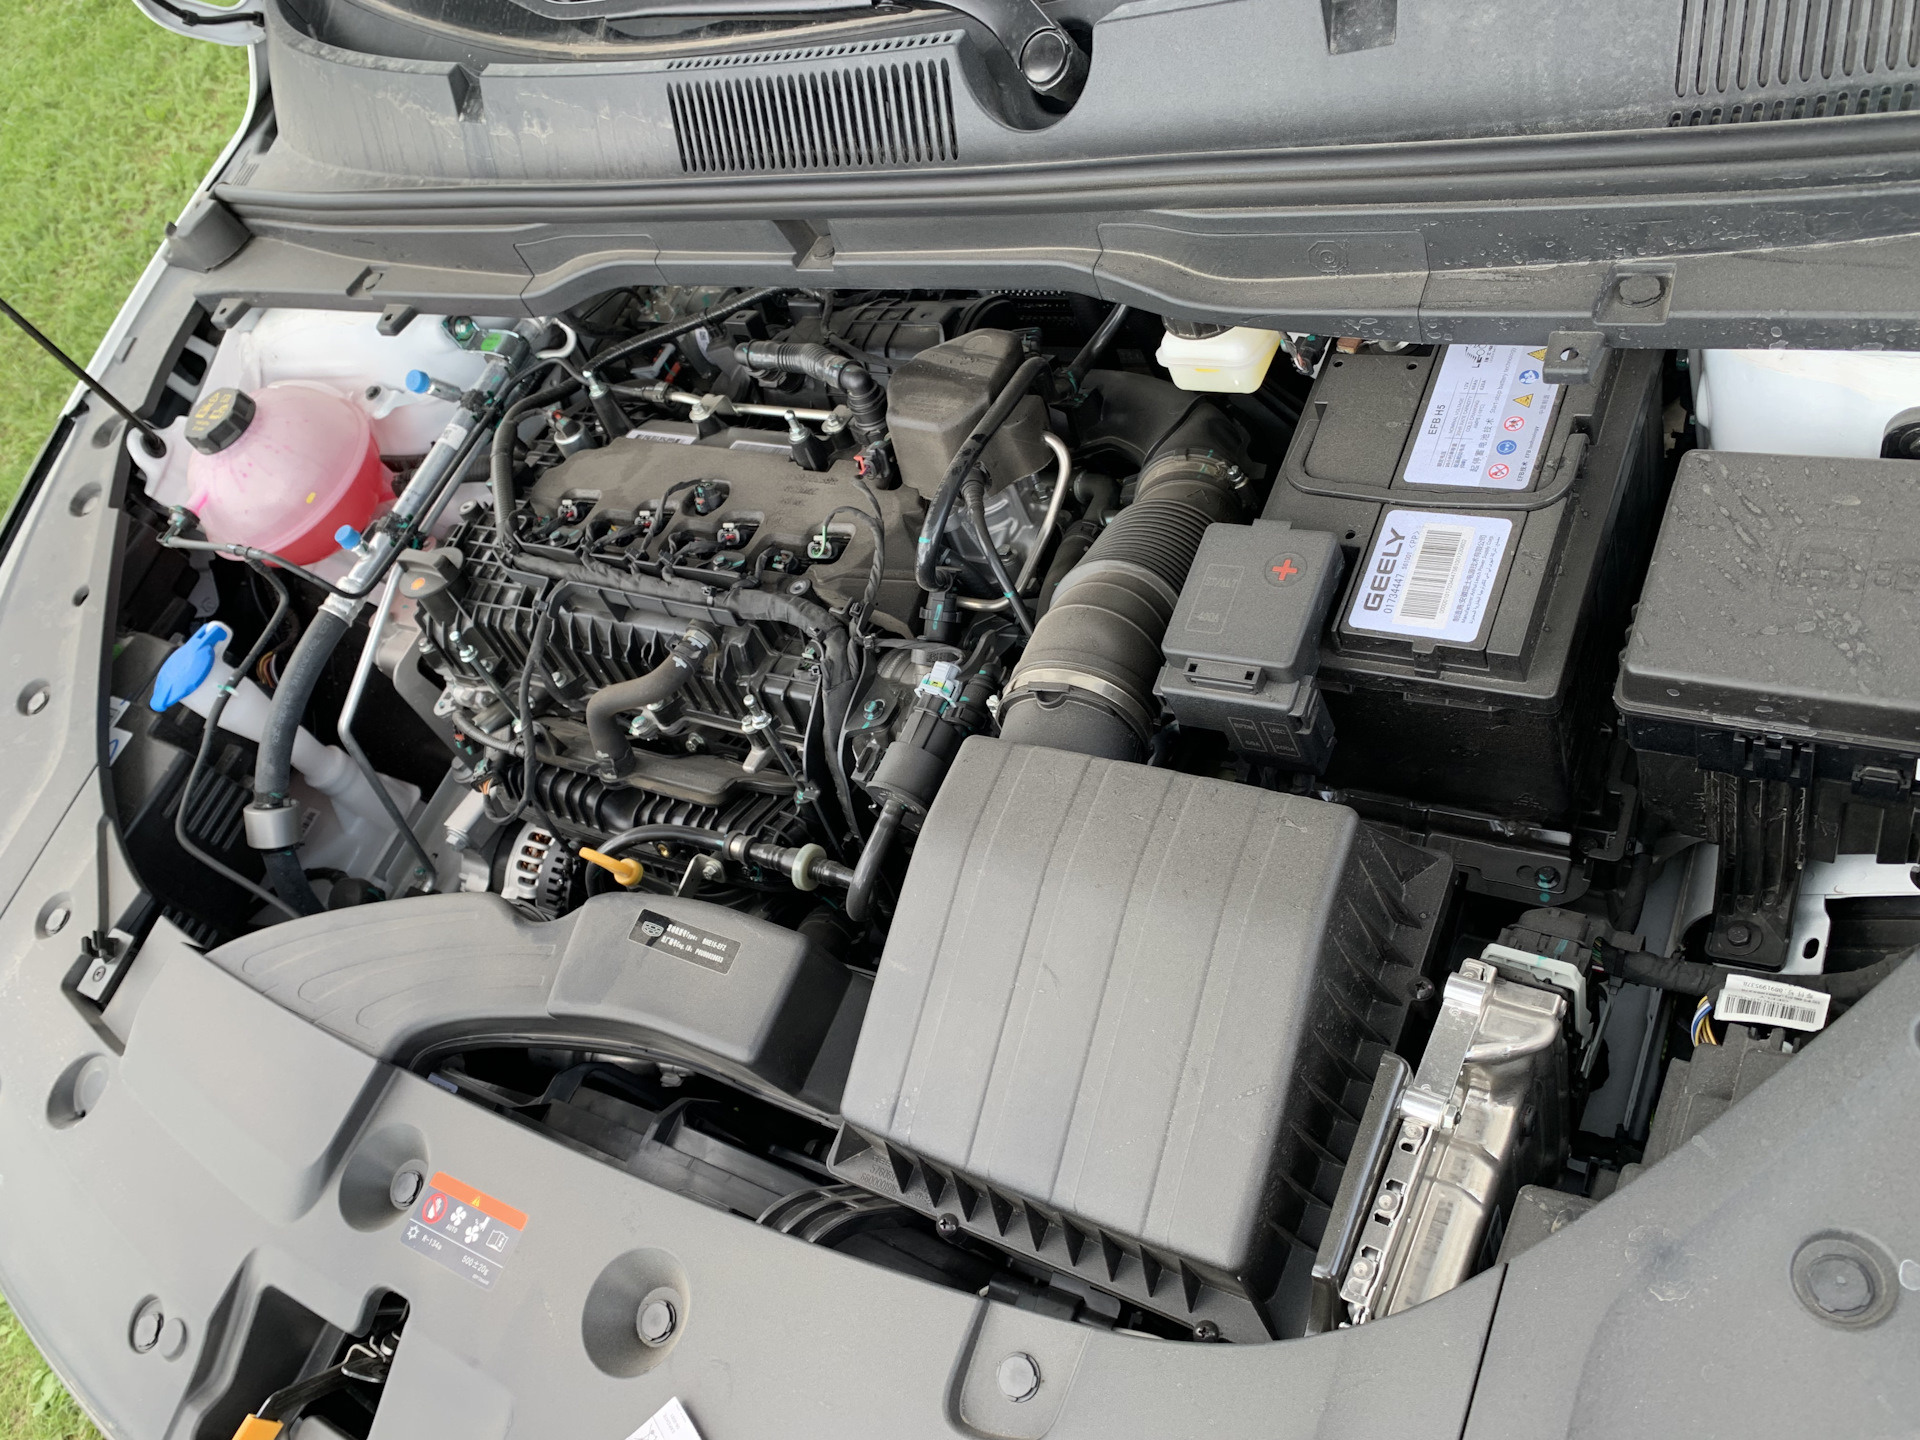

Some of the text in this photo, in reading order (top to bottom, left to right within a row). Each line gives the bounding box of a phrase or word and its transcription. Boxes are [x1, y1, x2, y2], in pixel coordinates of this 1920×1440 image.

[1488, 347, 1517, 413] Start-stop battery technology
[1427, 404, 1445, 434] EFB H5
[1362, 527, 1408, 611] GEELY
[1382, 573, 1404, 613] 01734447
[420, 1233, 444, 1251] R-134a
[444, 1223, 458, 1234] AUTO
